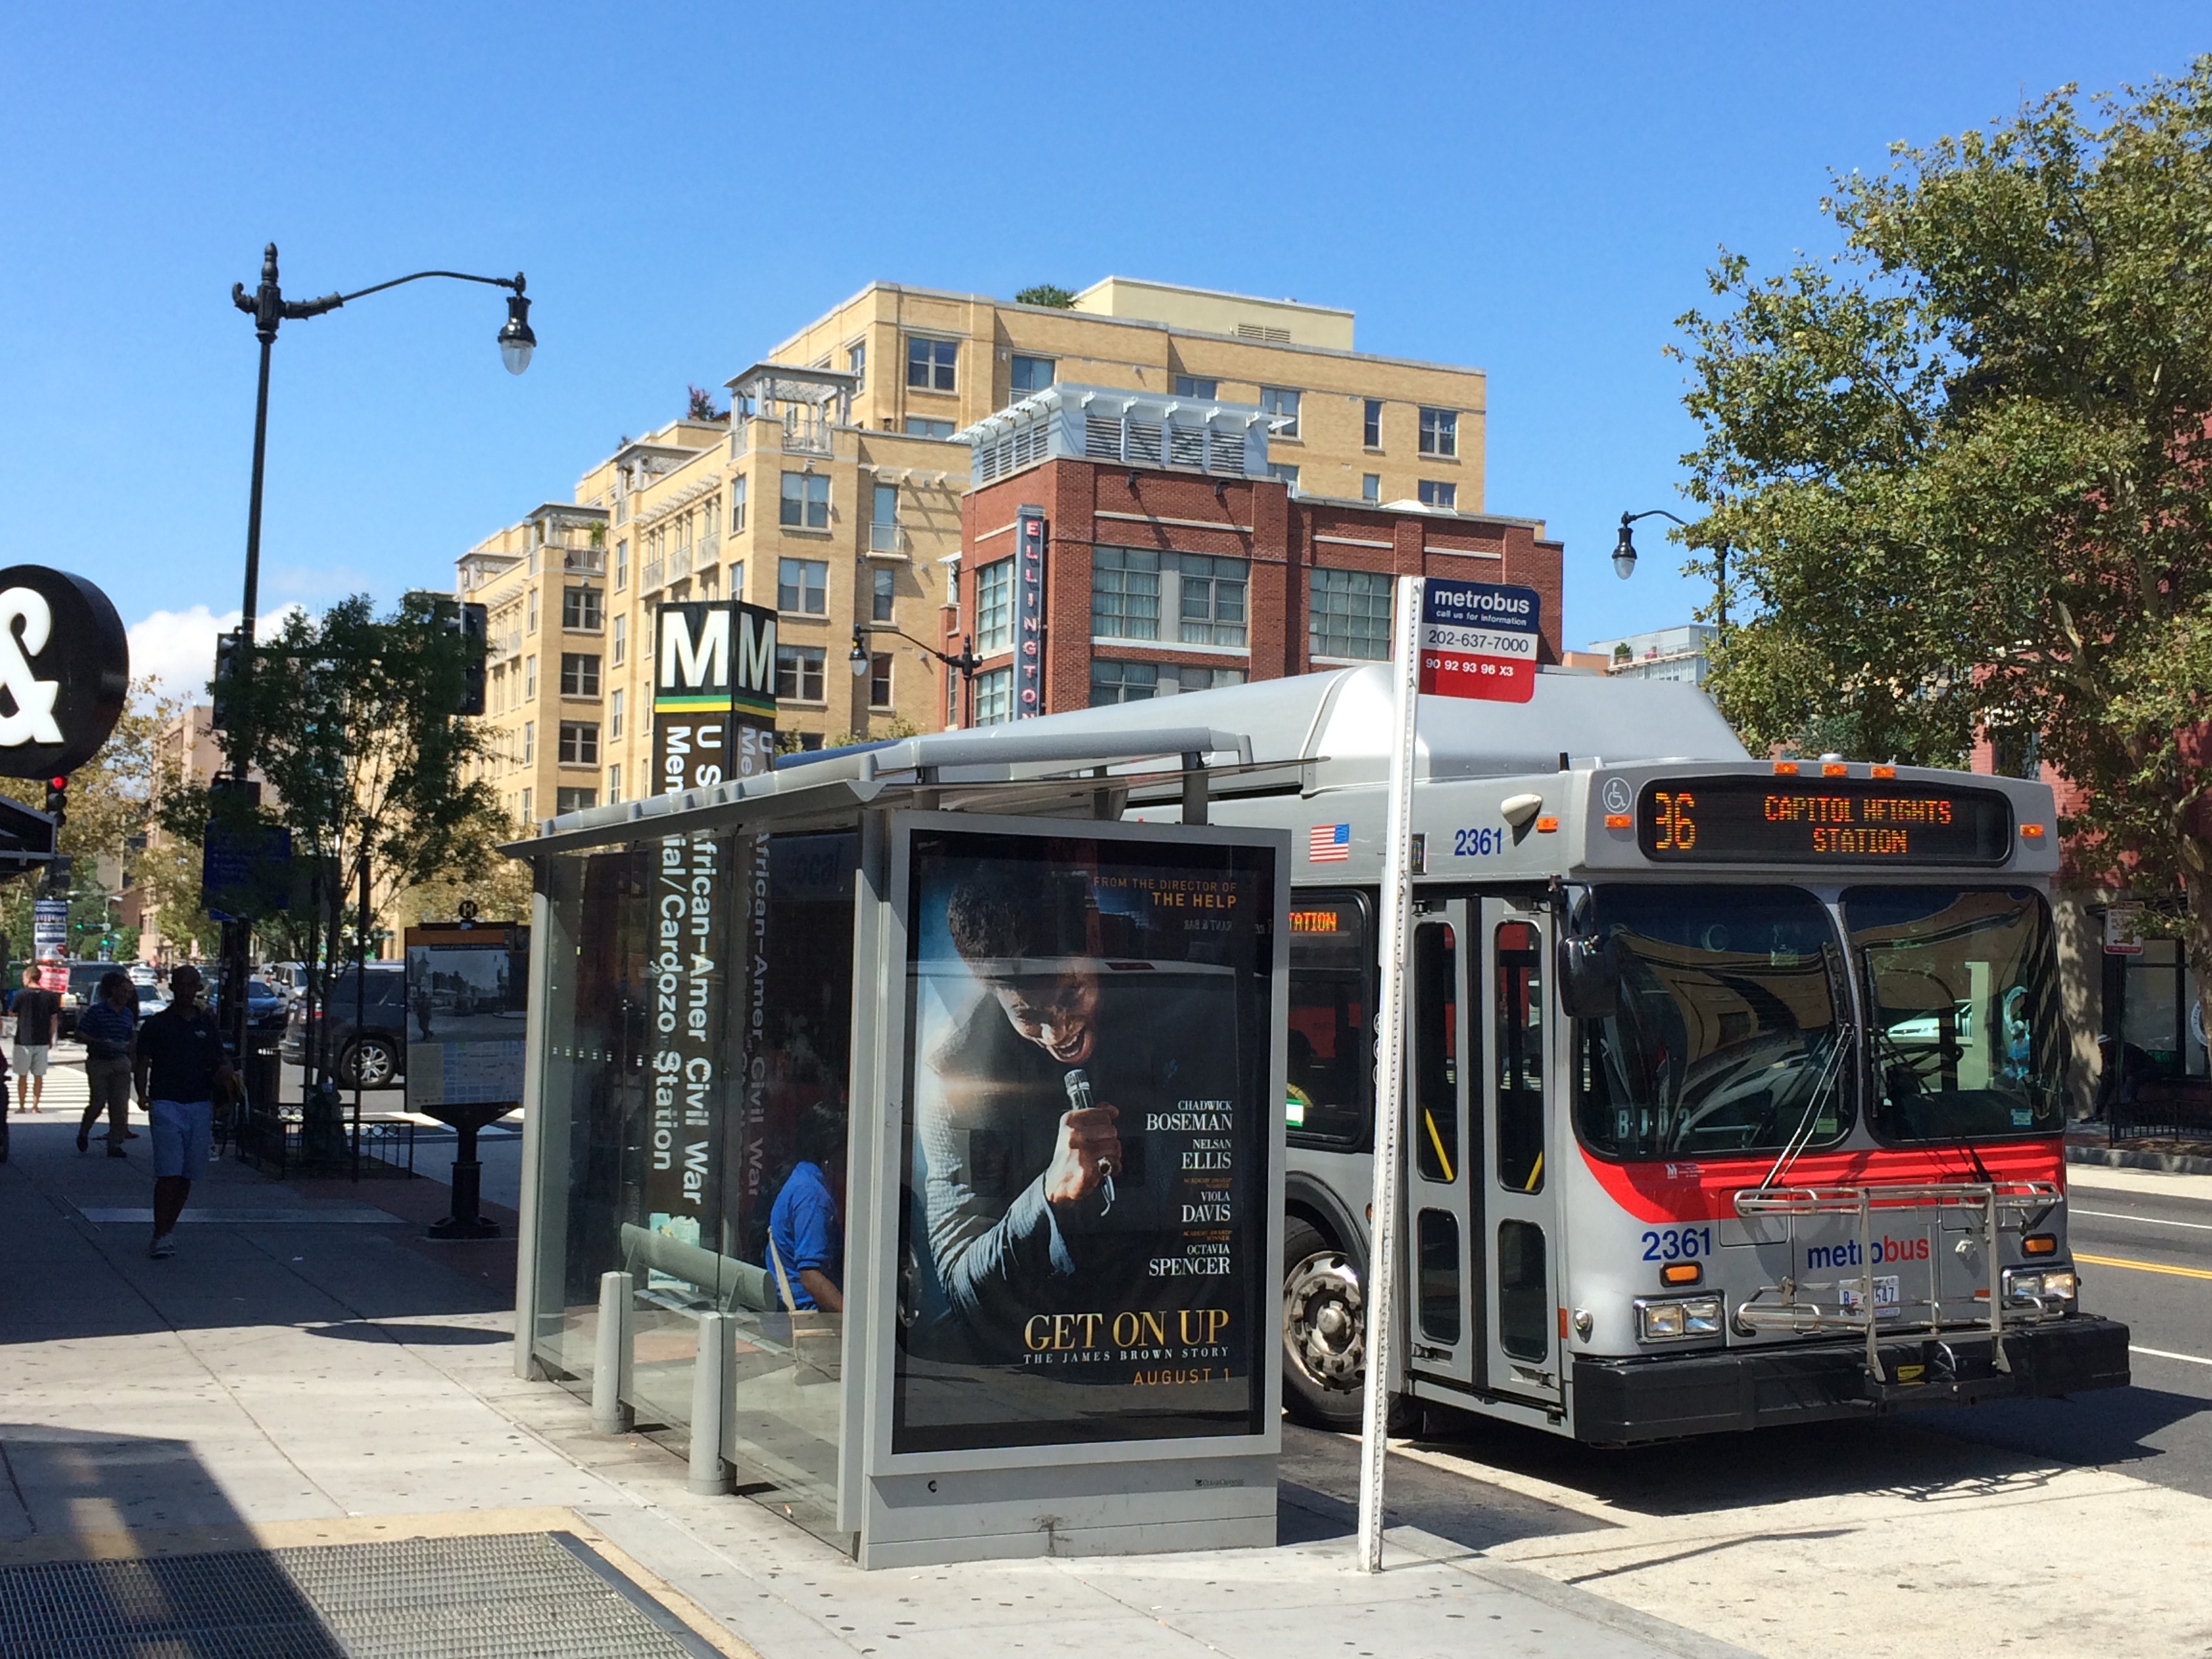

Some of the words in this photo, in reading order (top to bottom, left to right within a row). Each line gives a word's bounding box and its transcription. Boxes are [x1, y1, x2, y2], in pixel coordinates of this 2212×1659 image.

[1435, 590, 1530, 614] metrobus
[1436, 610, 1451, 618] call
[1467, 612, 1478, 620] for
[1481, 614, 1527, 626] information
[661, 610, 730, 687] M
[1428, 630, 1528, 653] 202-637-7000
[738, 612, 776, 695] M
[1426, 658, 1441, 669] 90
[1444, 660, 1459, 671] 92
[1462, 661, 1477, 672] 93
[1481, 663, 1496, 674] 96
[1499, 665, 1513, 676] X3
[697, 725, 722, 748] U
[759, 731, 773, 753] U
[1765, 795, 1855, 822] CAPITOL
[1863, 798, 1951, 825] HEIGHTS
[1454, 827, 1502, 856] 2361
[1813, 827, 1908, 853] STATION
[1093, 876, 1127, 888] FROM
[1133, 878, 1154, 889] THE
[1160, 880, 1217, 892] DIRECTOR
[1222, 882, 1237, 892] OF
[1152, 892, 1185, 907] THE
[1193, 893, 1237, 908] HELP
[1288, 912, 1337, 932] TATION
[685, 1057, 712, 1126] Civil
[751, 1057, 765, 1122] Civil
[653, 1050, 681, 1170] Station
[1178, 1100, 1233, 1111] CHADWICK
[1145, 1113, 1233, 1130] BOSEMAN
[1193, 1139, 1232, 1149] NELSAN
[748, 1137, 763, 1195] War
[1181, 1152, 1232, 1169] ELLIS
[682, 1141, 709, 1204] War
[1201, 1191, 1230, 1202] VIOLA
[1181, 1204, 1231, 1223] DAVIS
[1187, 1244, 1230, 1255] OCTAVIA
[1641, 1227, 1711, 1261] 2361
[1807, 1235, 1929, 1269] metrobus
[1149, 1256, 1231, 1276] SPENCER
[1024, 1313, 1103, 1351] GET
[1113, 1311, 1167, 1347] ON
[1177, 1309, 1229, 1345] UP
[1024, 1353, 1052, 1364] THE
[1063, 1351, 1110, 1364] JAMES
[1120, 1349, 1173, 1361] BROWN
[1182, 1347, 1229, 1359] STORY
[1133, 1368, 1212, 1386] AUGUST
[1223, 1368, 1229, 1382] 1
